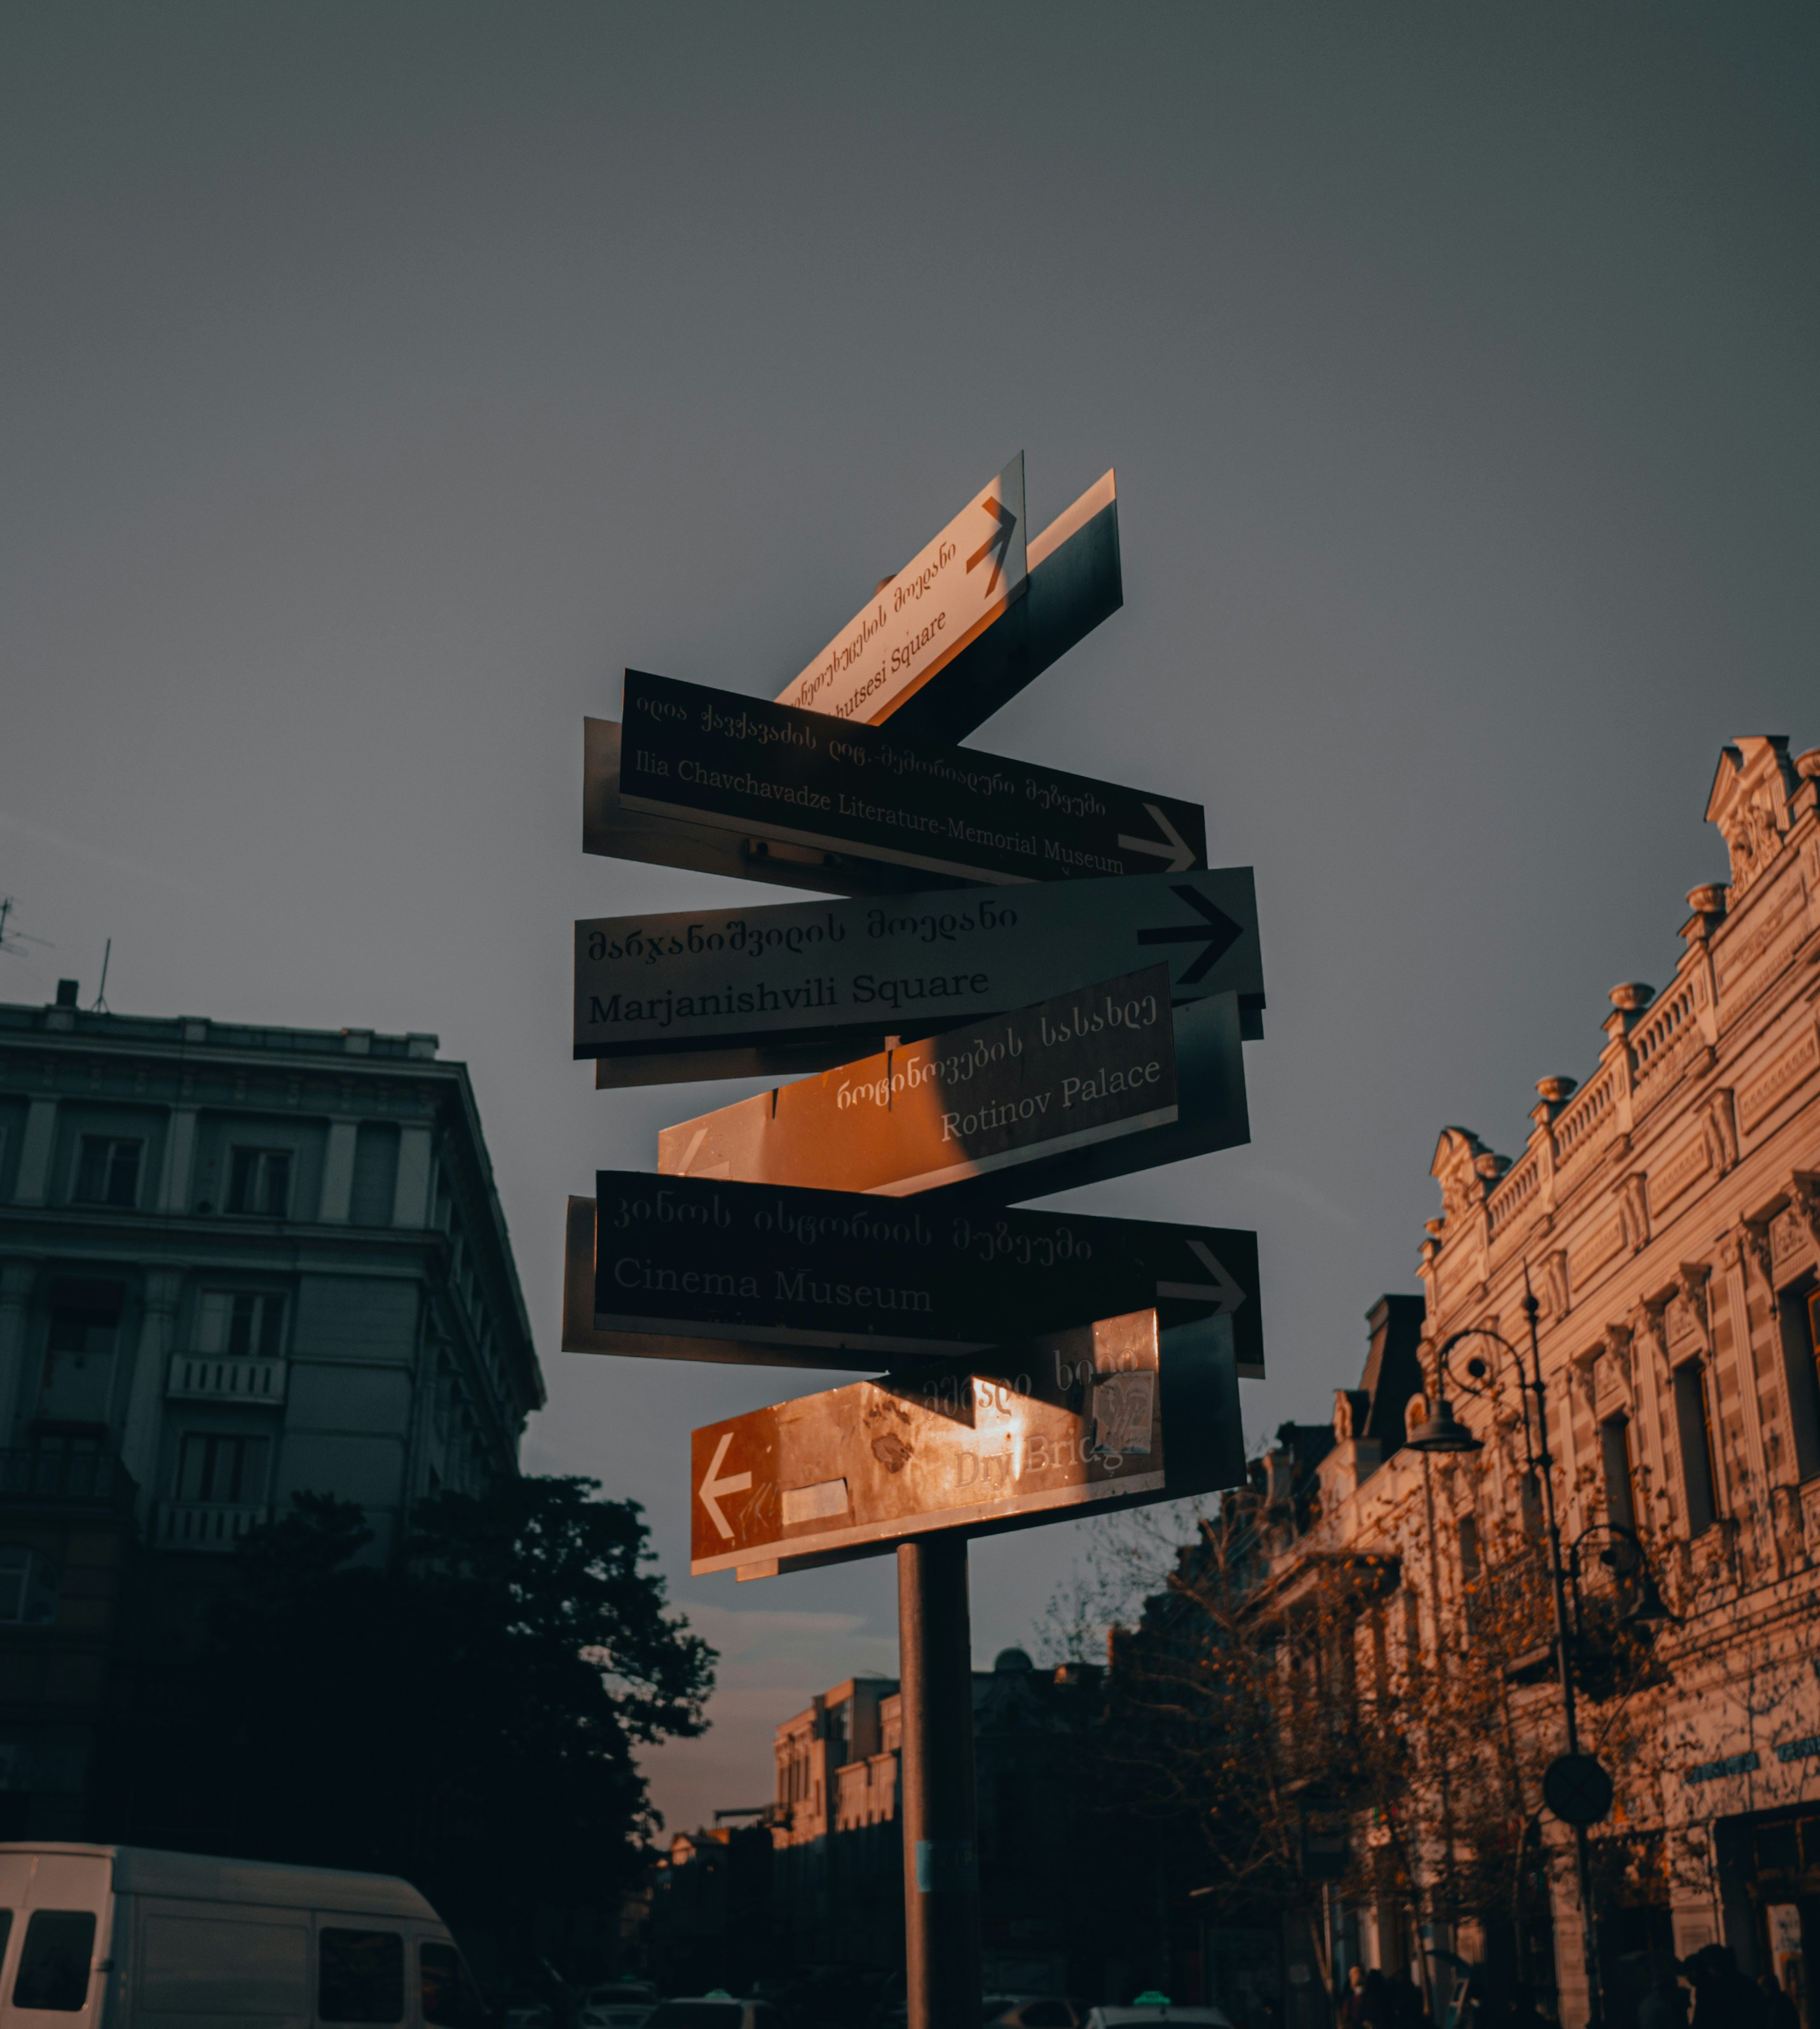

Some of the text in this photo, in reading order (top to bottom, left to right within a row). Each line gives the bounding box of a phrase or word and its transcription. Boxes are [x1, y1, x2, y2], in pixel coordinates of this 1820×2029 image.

[791, 541, 956, 707] ინეთუხუცესის მოედანი
[827, 612, 946, 718] hutsesi Square
[636, 697, 687, 722] ილია
[701, 704, 817, 749] ჭავჭავაძის
[1026, 779, 1105, 817] მუზეუმი
[636, 750, 1124, 875] Ilia Chavchavadze Literature-Memorial Museum
[589, 900, 1017, 964] მარჯანიშვილის მოედანი
[589, 973, 989, 1026] Marjanishvili Square
[836, 994, 1158, 1110] როტინოვების სასახლე
[941, 1058, 1160, 1143] Rotinov Palace
[613, 1191, 1092, 1266] კინოს ისტორიის მუზეუმი
[615, 1257, 933, 1312] Cinema Museum
[955, 1450, 1015, 1490] Dry
